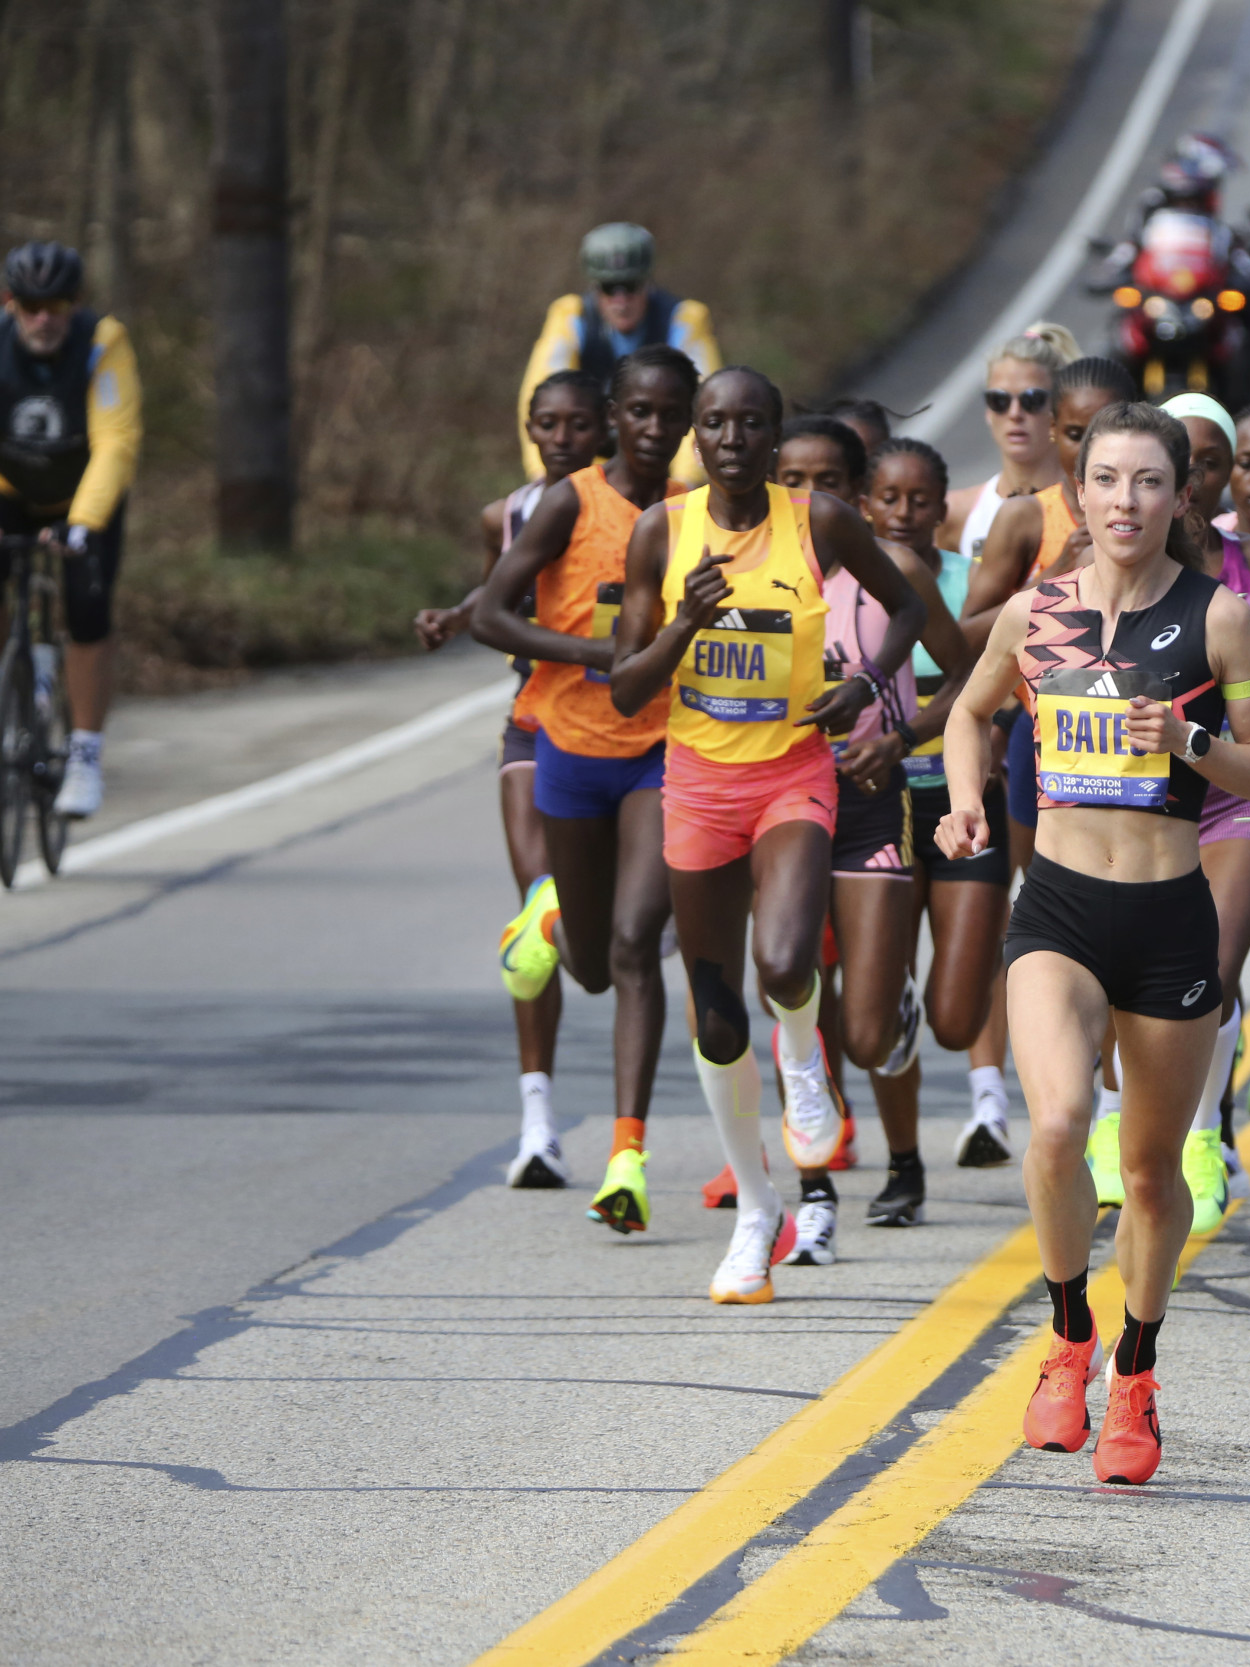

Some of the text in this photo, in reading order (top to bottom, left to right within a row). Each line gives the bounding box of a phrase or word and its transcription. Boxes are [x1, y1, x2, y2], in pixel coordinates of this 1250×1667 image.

[694, 640, 766, 681] EDNA
[710, 698, 747, 708] BOSTON
[1056, 709, 1148, 756] BATE
[1063, 776, 1081, 785] 128TH
[1083, 778, 1121, 788] BOSTON
[1063, 786, 1123, 797] MARATHON
